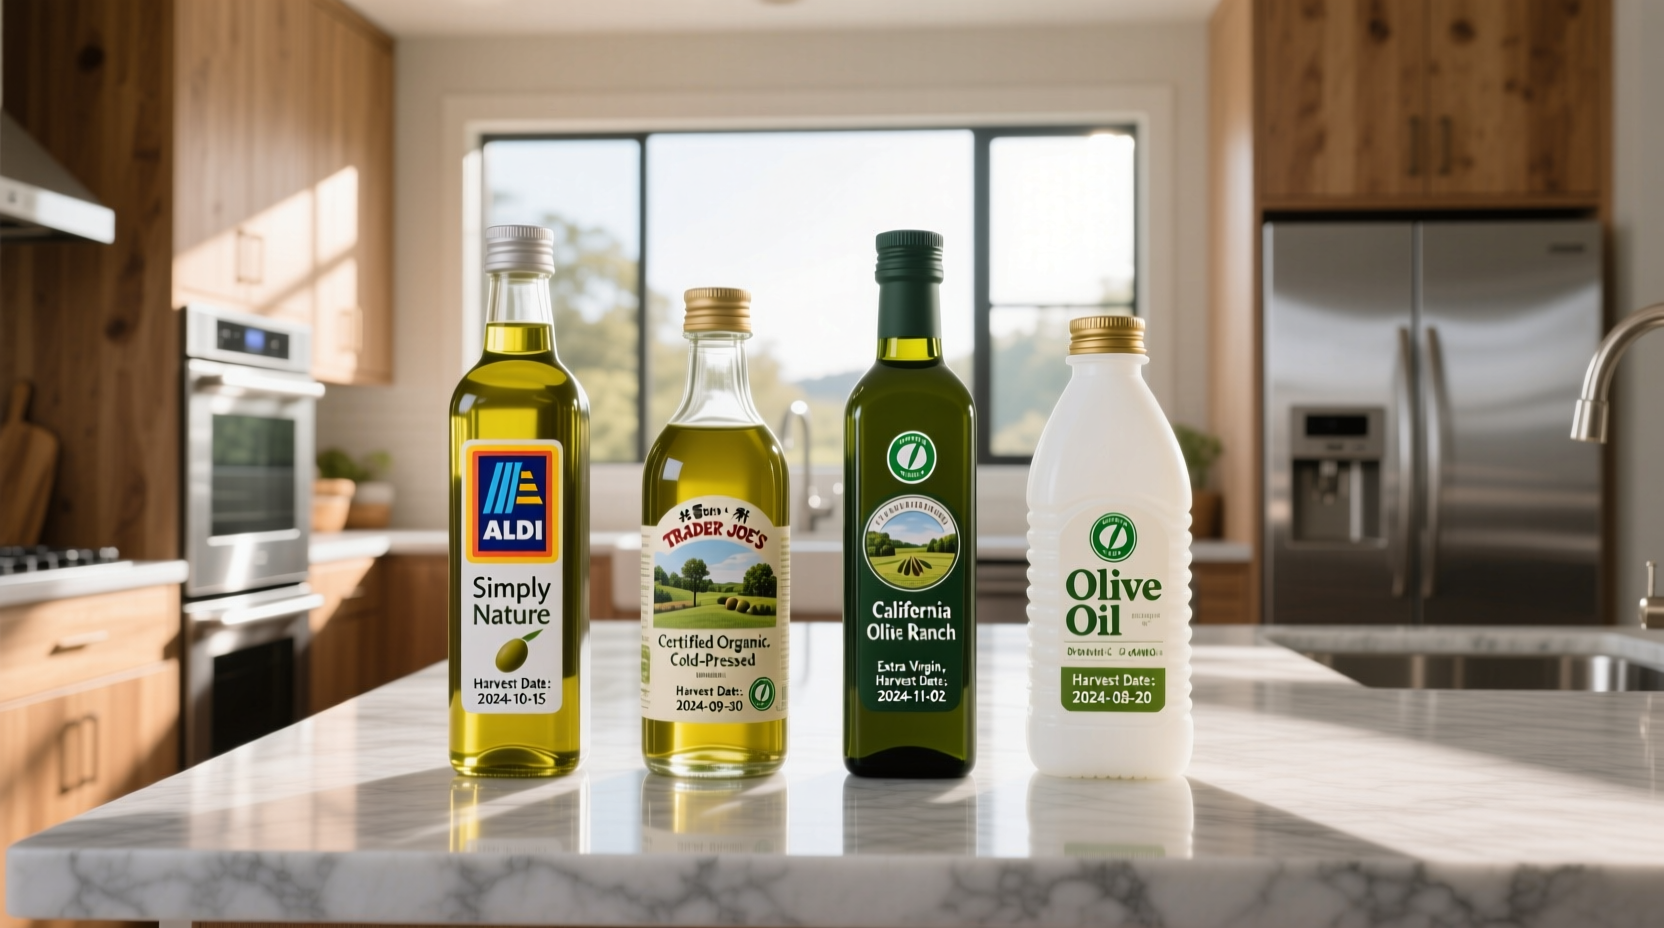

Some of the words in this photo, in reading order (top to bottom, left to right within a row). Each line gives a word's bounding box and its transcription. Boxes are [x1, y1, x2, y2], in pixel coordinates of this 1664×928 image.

[482, 519, 543, 541] ALDI
[662, 521, 724, 548] TRADER
[726, 524, 768, 550] JOE'S
[472, 575, 552, 605] Simply
[1065, 568, 1163, 602] Olive
[473, 603, 551, 625] Nature
[1065, 603, 1122, 637] Oil
[907, 622, 956, 641] Ranch
[658, 633, 714, 649] Certified
[670, 652, 756, 667] Cold-Pressed
[877, 660, 906, 672] Extra
[473, 678, 518, 689] Harvest
[520, 677, 551, 690] Date:
[876, 674, 917, 686] Harvest
[1072, 673, 1120, 686] Harvest
[1123, 674, 1156, 687] Date:
[477, 692, 546, 705] 2024-10-15
[676, 685, 714, 697] Harvest
[877, 690, 947, 702] 2024-11-02
[676, 699, 743, 712] 2024-09-30
